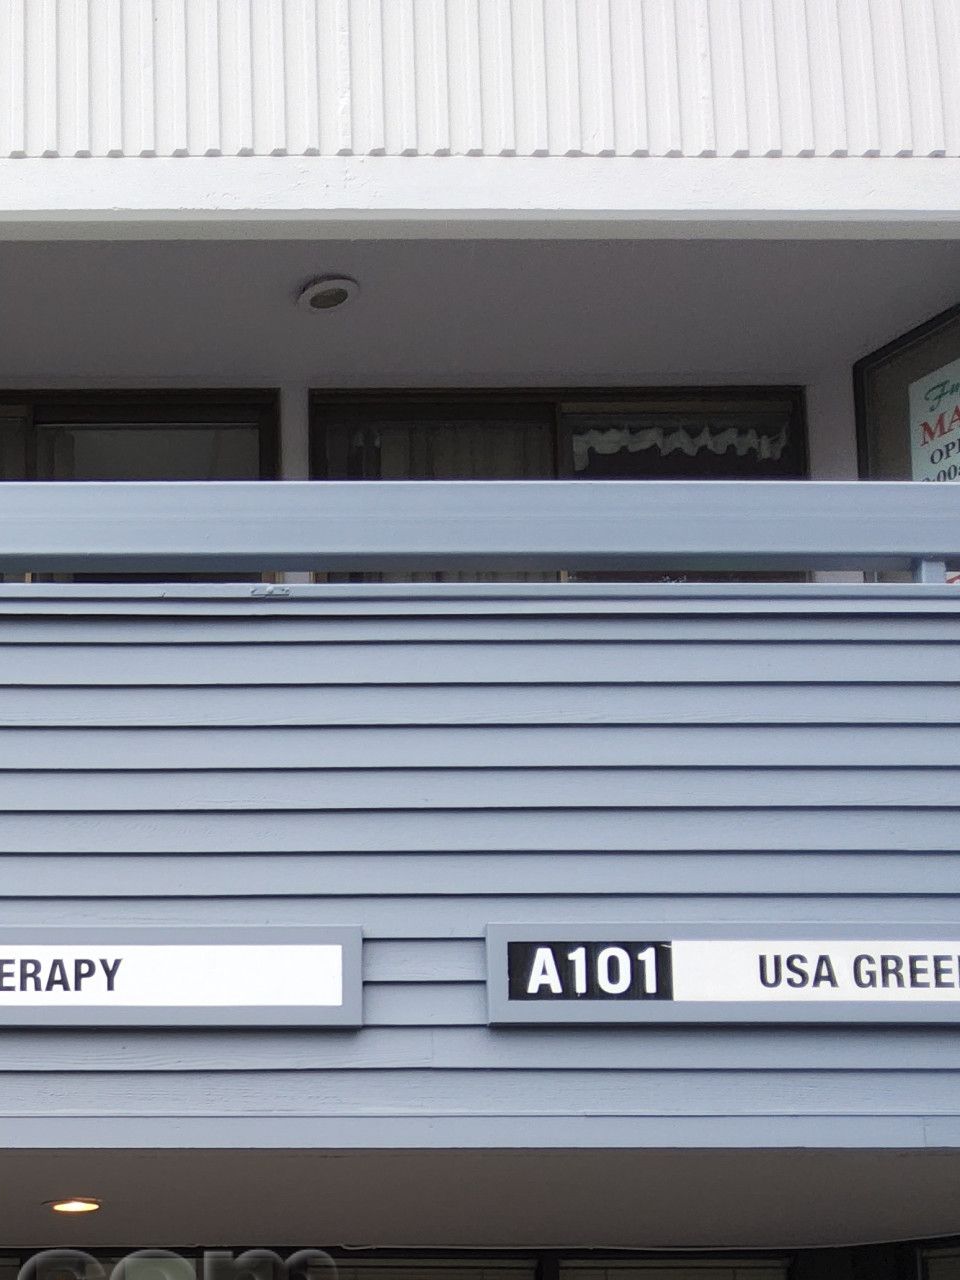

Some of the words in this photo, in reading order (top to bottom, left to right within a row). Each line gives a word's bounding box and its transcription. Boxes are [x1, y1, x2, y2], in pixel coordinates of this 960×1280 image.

[526, 946, 658, 995] A101
[758, 953, 840, 988] USA
[853, 954, 960, 988] GREE
